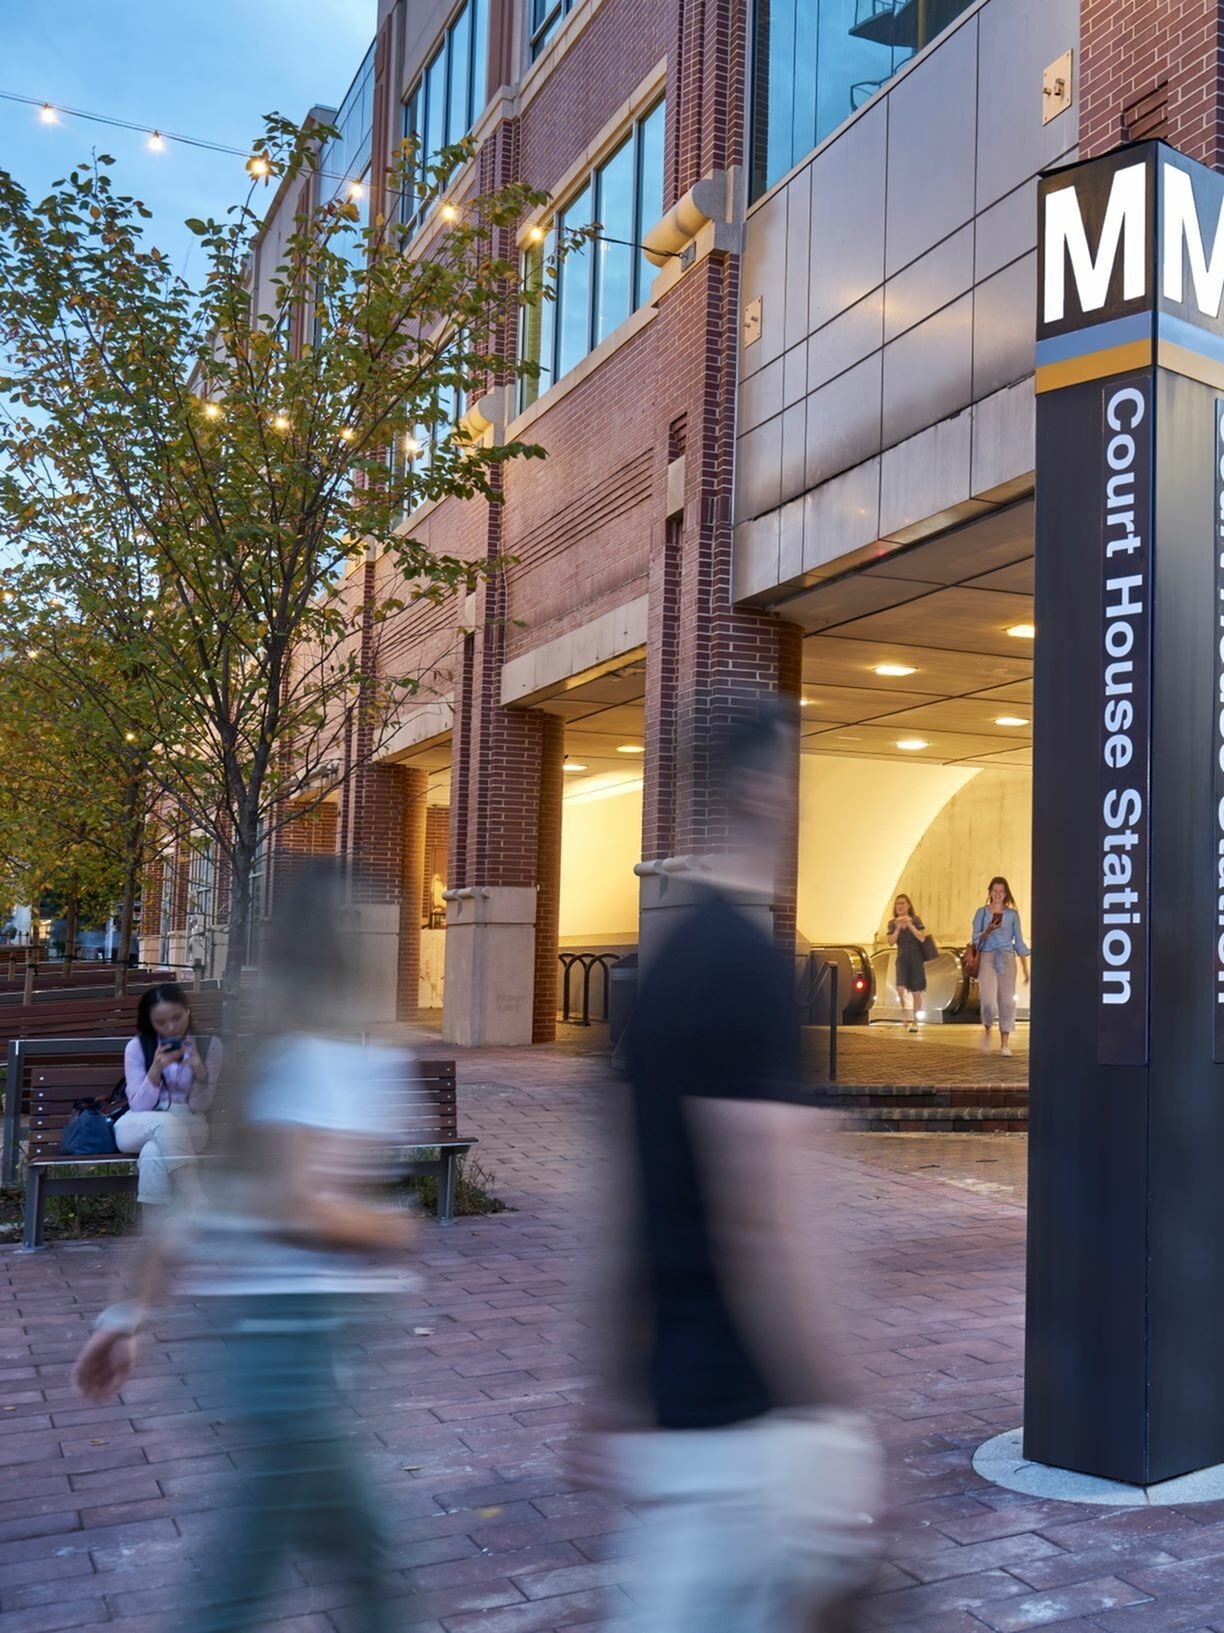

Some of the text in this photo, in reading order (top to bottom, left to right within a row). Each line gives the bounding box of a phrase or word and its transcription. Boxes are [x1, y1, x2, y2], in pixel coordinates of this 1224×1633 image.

[1043, 161, 1147, 324] M
[1102, 387, 1145, 1005] Court House Station
